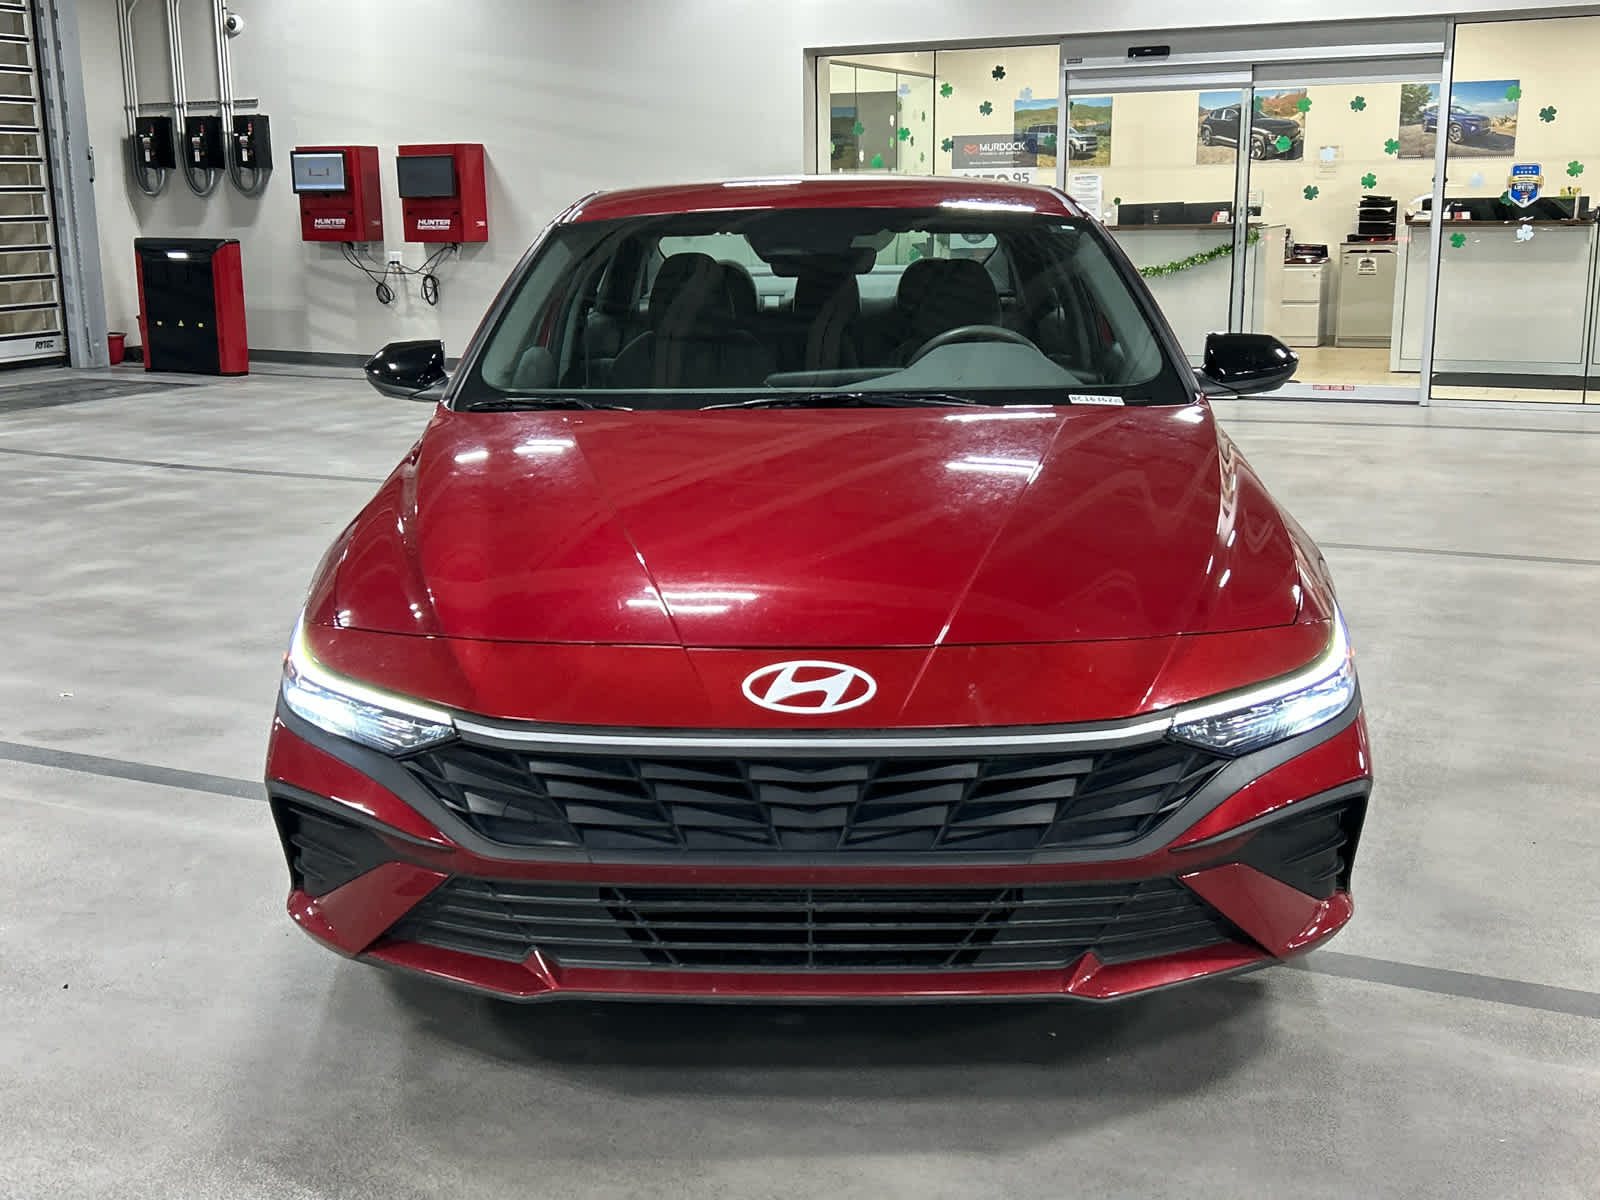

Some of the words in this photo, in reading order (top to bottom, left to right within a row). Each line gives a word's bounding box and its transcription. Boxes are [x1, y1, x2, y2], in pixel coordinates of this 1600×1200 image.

[980, 142, 1025, 151] MURDOCK
[314, 218, 346, 226] HUNTER
[417, 219, 451, 227] HUNTER
